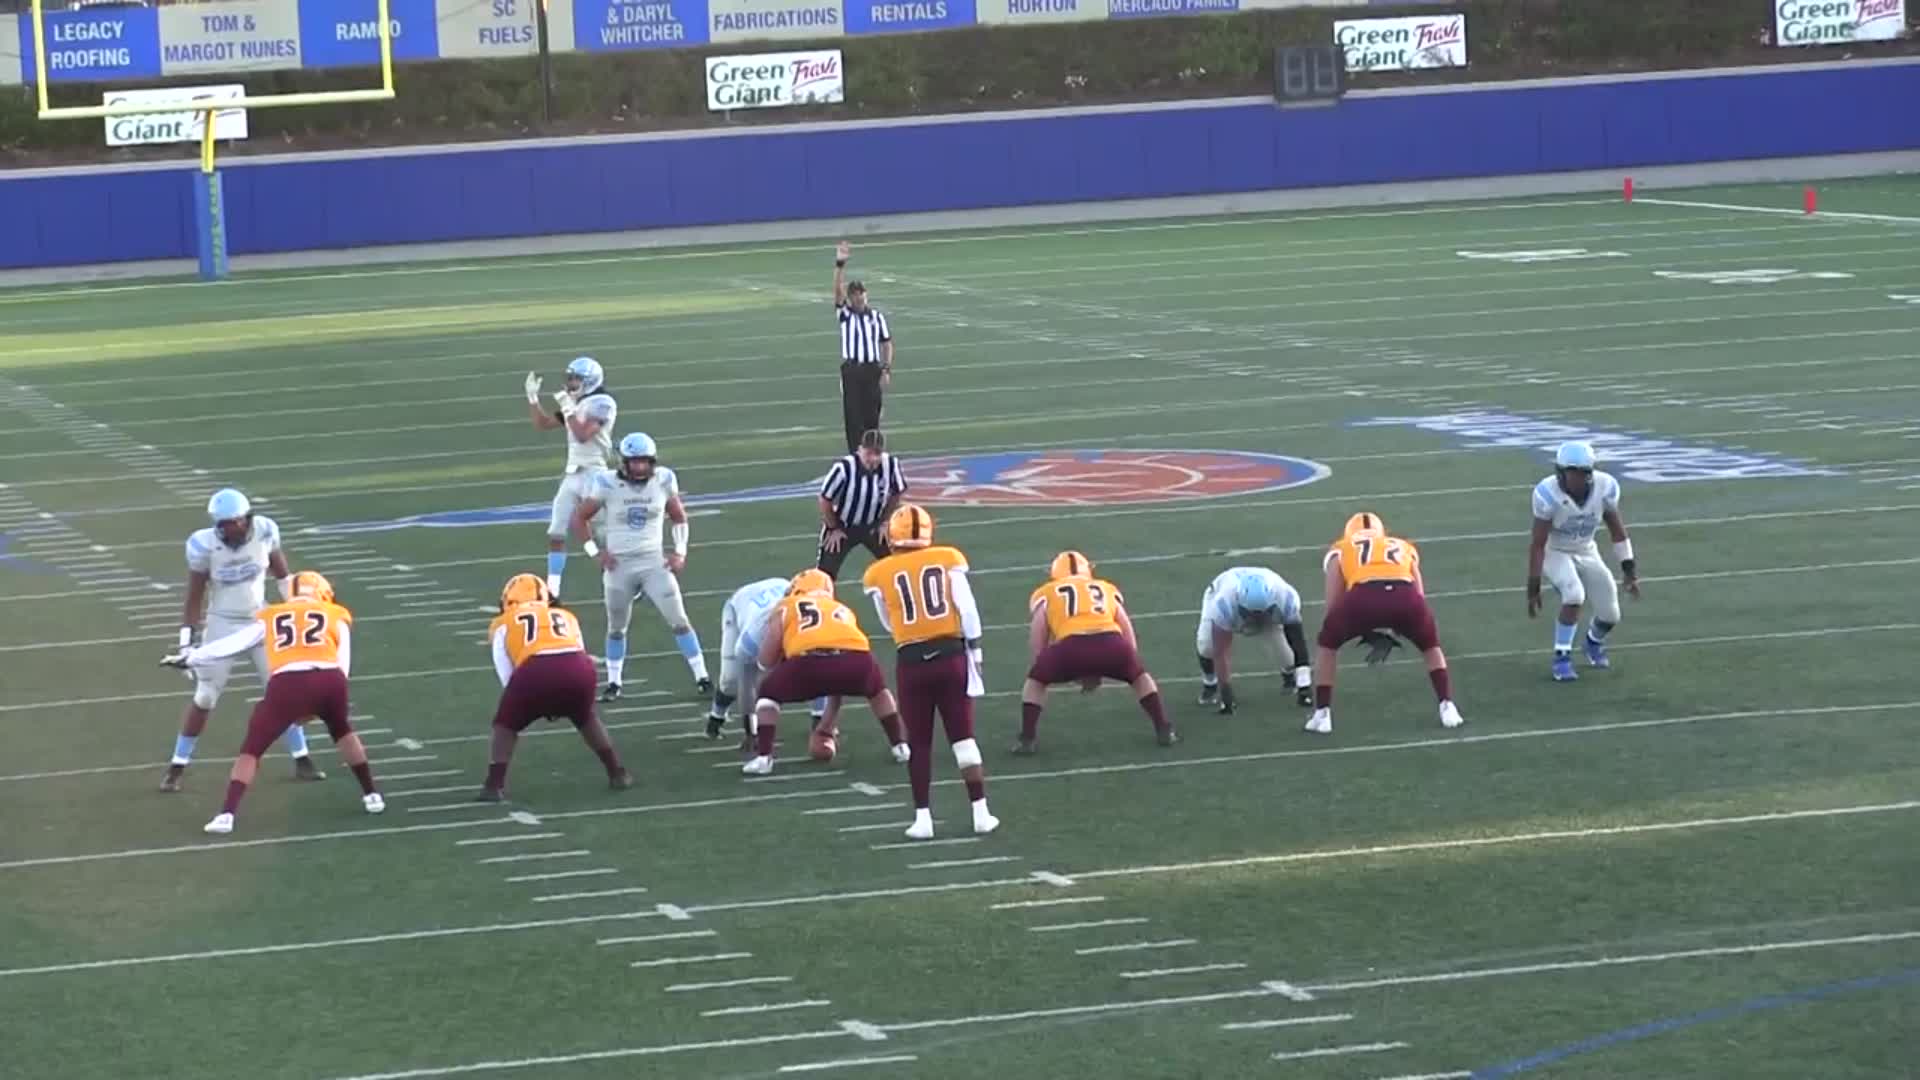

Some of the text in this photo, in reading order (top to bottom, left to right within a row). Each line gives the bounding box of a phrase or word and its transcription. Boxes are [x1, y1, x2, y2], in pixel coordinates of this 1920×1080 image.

[608, 3, 677, 25] & DARYL
[713, 7, 838, 31] FABRICATIONS
[871, 1, 948, 23] RENTALS
[1779, 0, 1850, 20] Green
[53, 21, 124, 42] LEGACY
[201, 14, 257, 32] TOM &
[479, 25, 533, 45] FUELS
[600, 24, 684, 45] WHITCHER
[1337, 25, 1409, 47] Green
[51, 47, 131, 70] ROOFING
[164, 39, 297, 62] MARGOT NUNES
[1344, 46, 1408, 68] Giant
[709, 61, 785, 84] Green
[714, 84, 782, 105] Giant
[113, 119, 183, 141] Giant
[1353, 537, 1400, 565] 72
[895, 565, 949, 624] 10
[1056, 584, 1105, 617] 73
[273, 610, 328, 651] 52
